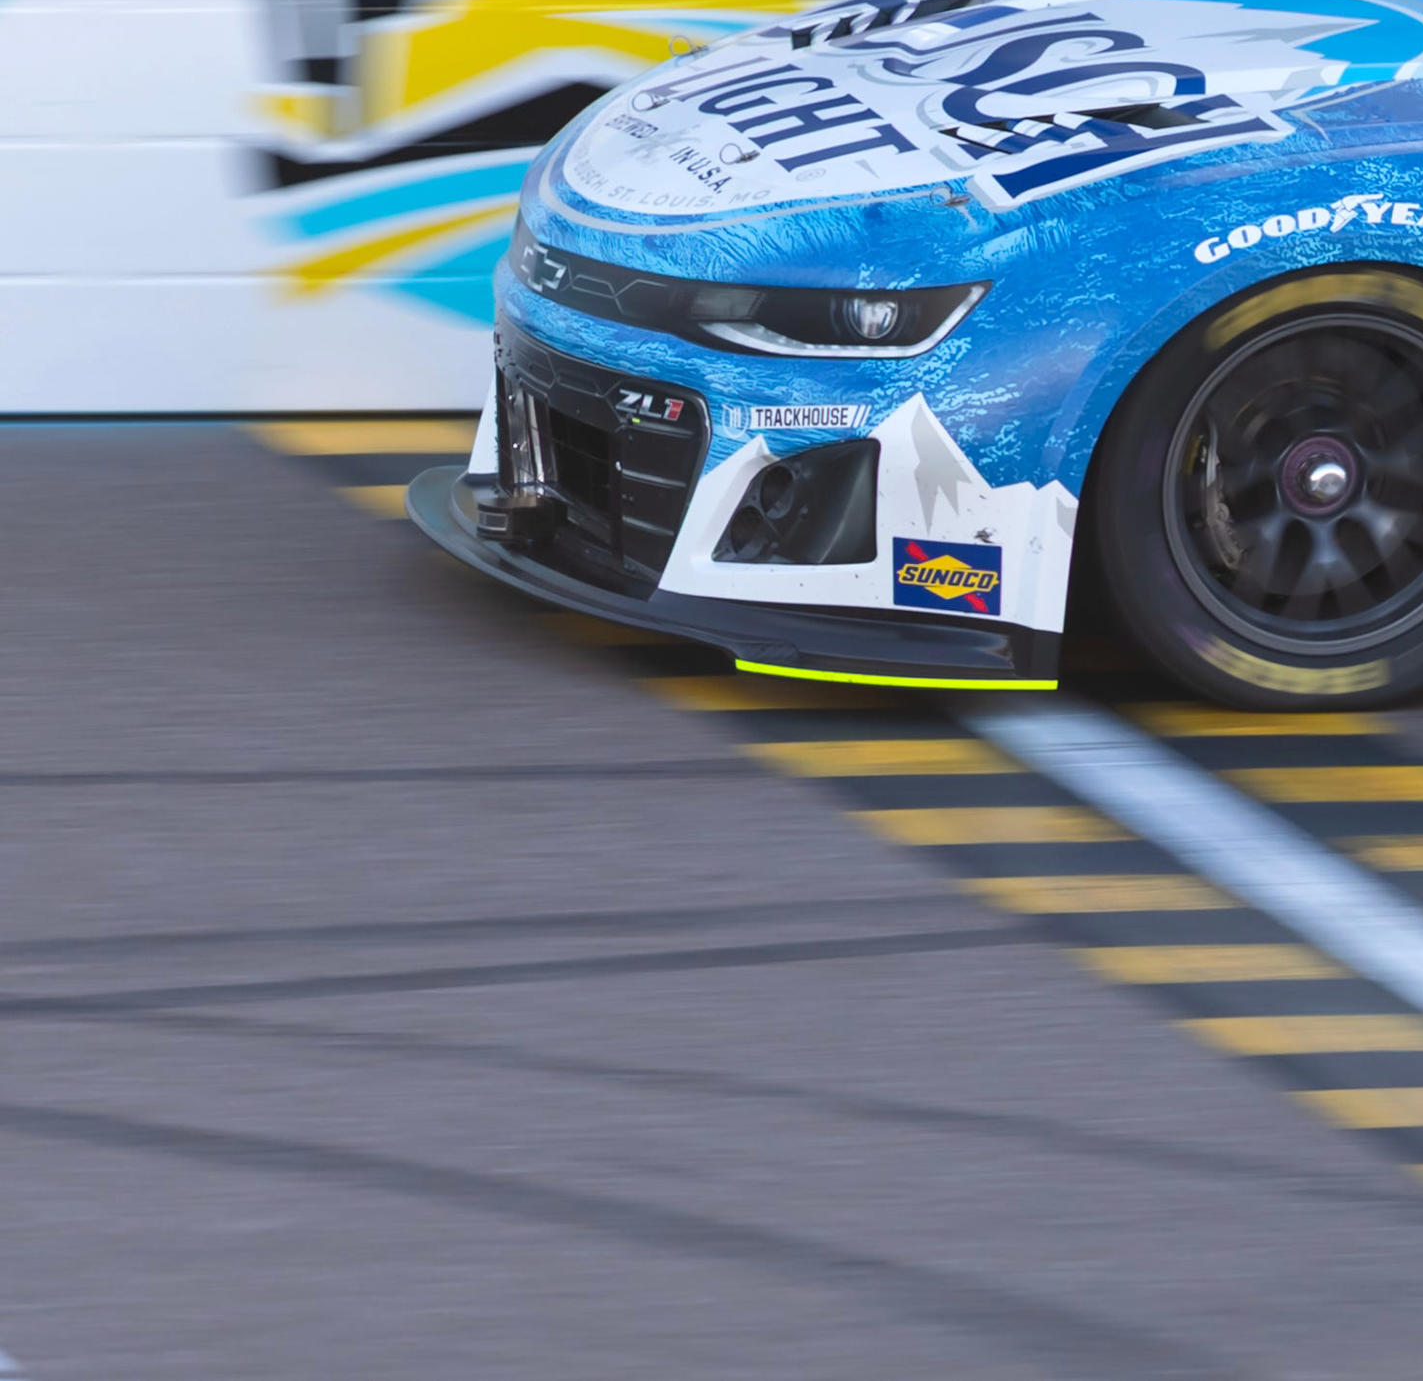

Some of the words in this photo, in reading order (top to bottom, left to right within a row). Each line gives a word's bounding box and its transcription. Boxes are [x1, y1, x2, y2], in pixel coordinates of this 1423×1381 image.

[643, 56, 920, 173] LIGHT
[669, 145, 700, 165] IN
[616, 388, 686, 422] ZL1
[755, 407, 849, 427] TRACKHOUSE
[900, 564, 997, 591] SUNOCO
